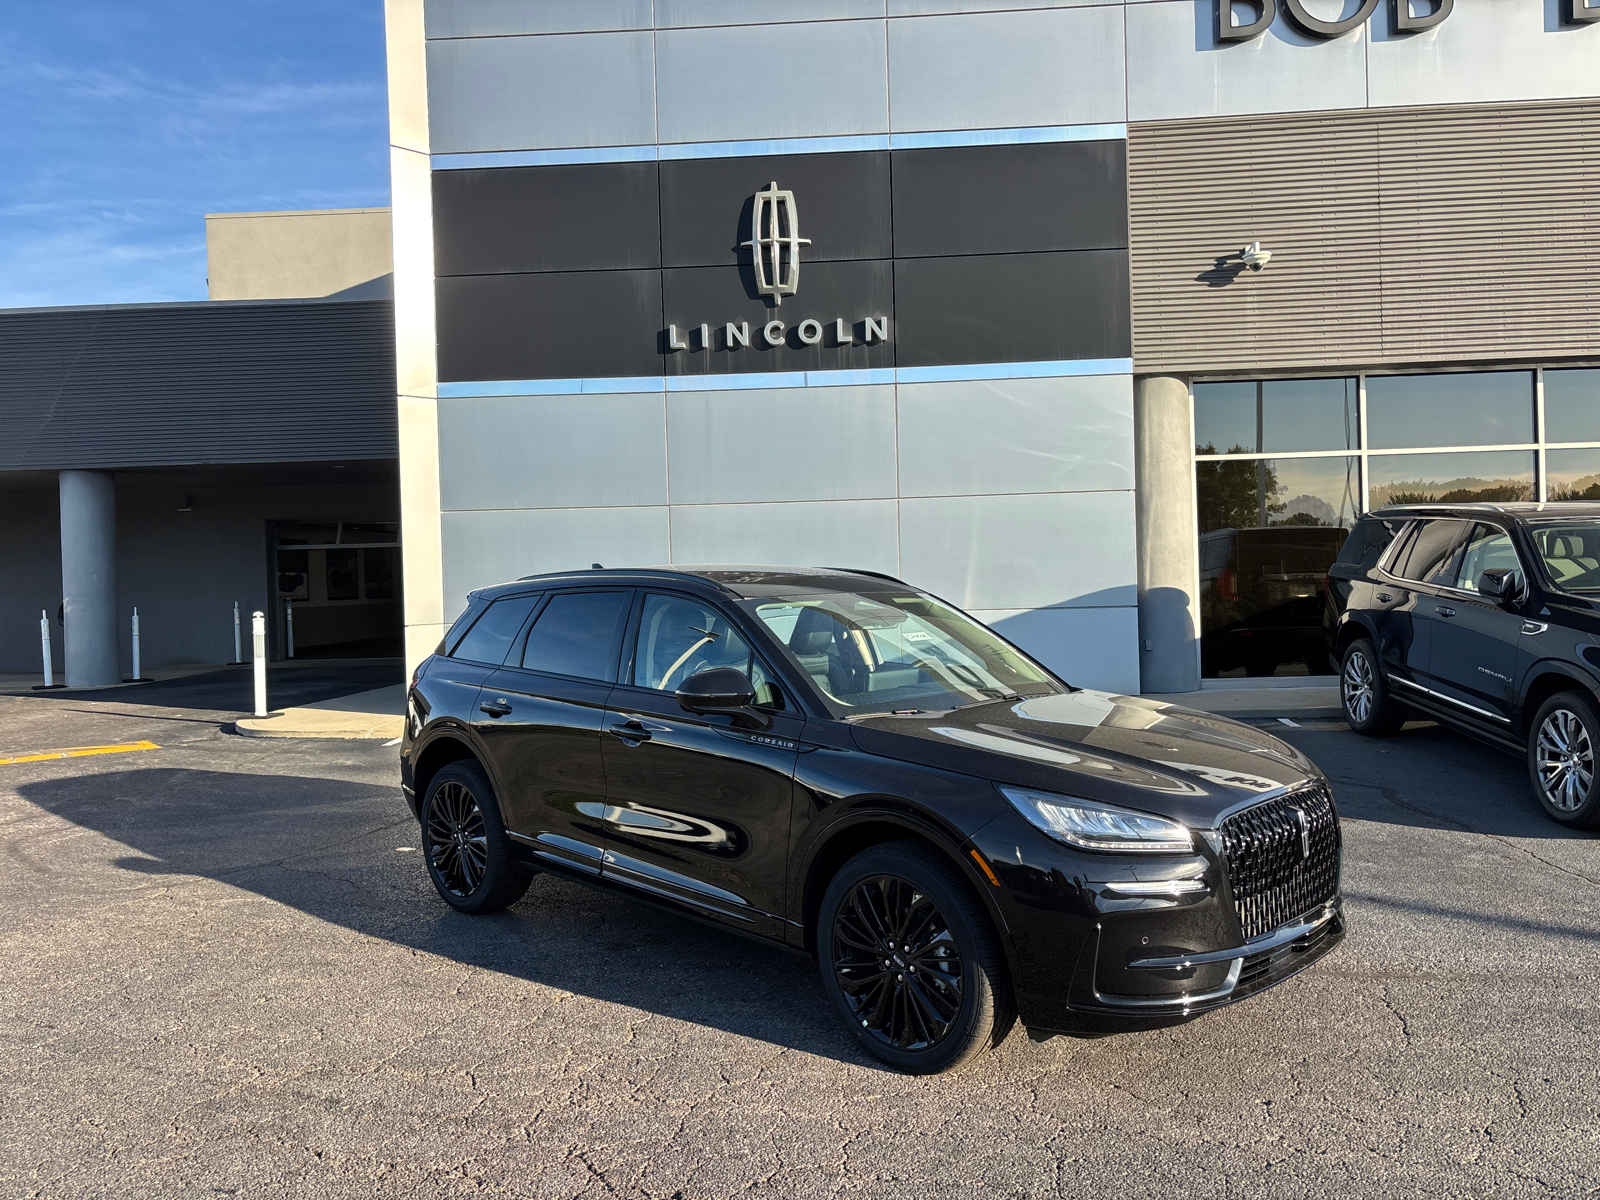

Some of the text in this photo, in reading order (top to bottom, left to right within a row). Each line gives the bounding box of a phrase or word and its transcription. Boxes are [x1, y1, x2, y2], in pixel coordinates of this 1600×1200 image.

[669, 316, 888, 350] LINCOLN
[1477, 666, 1512, 683] DENALI
[750, 735, 794, 749] CORSAIR
